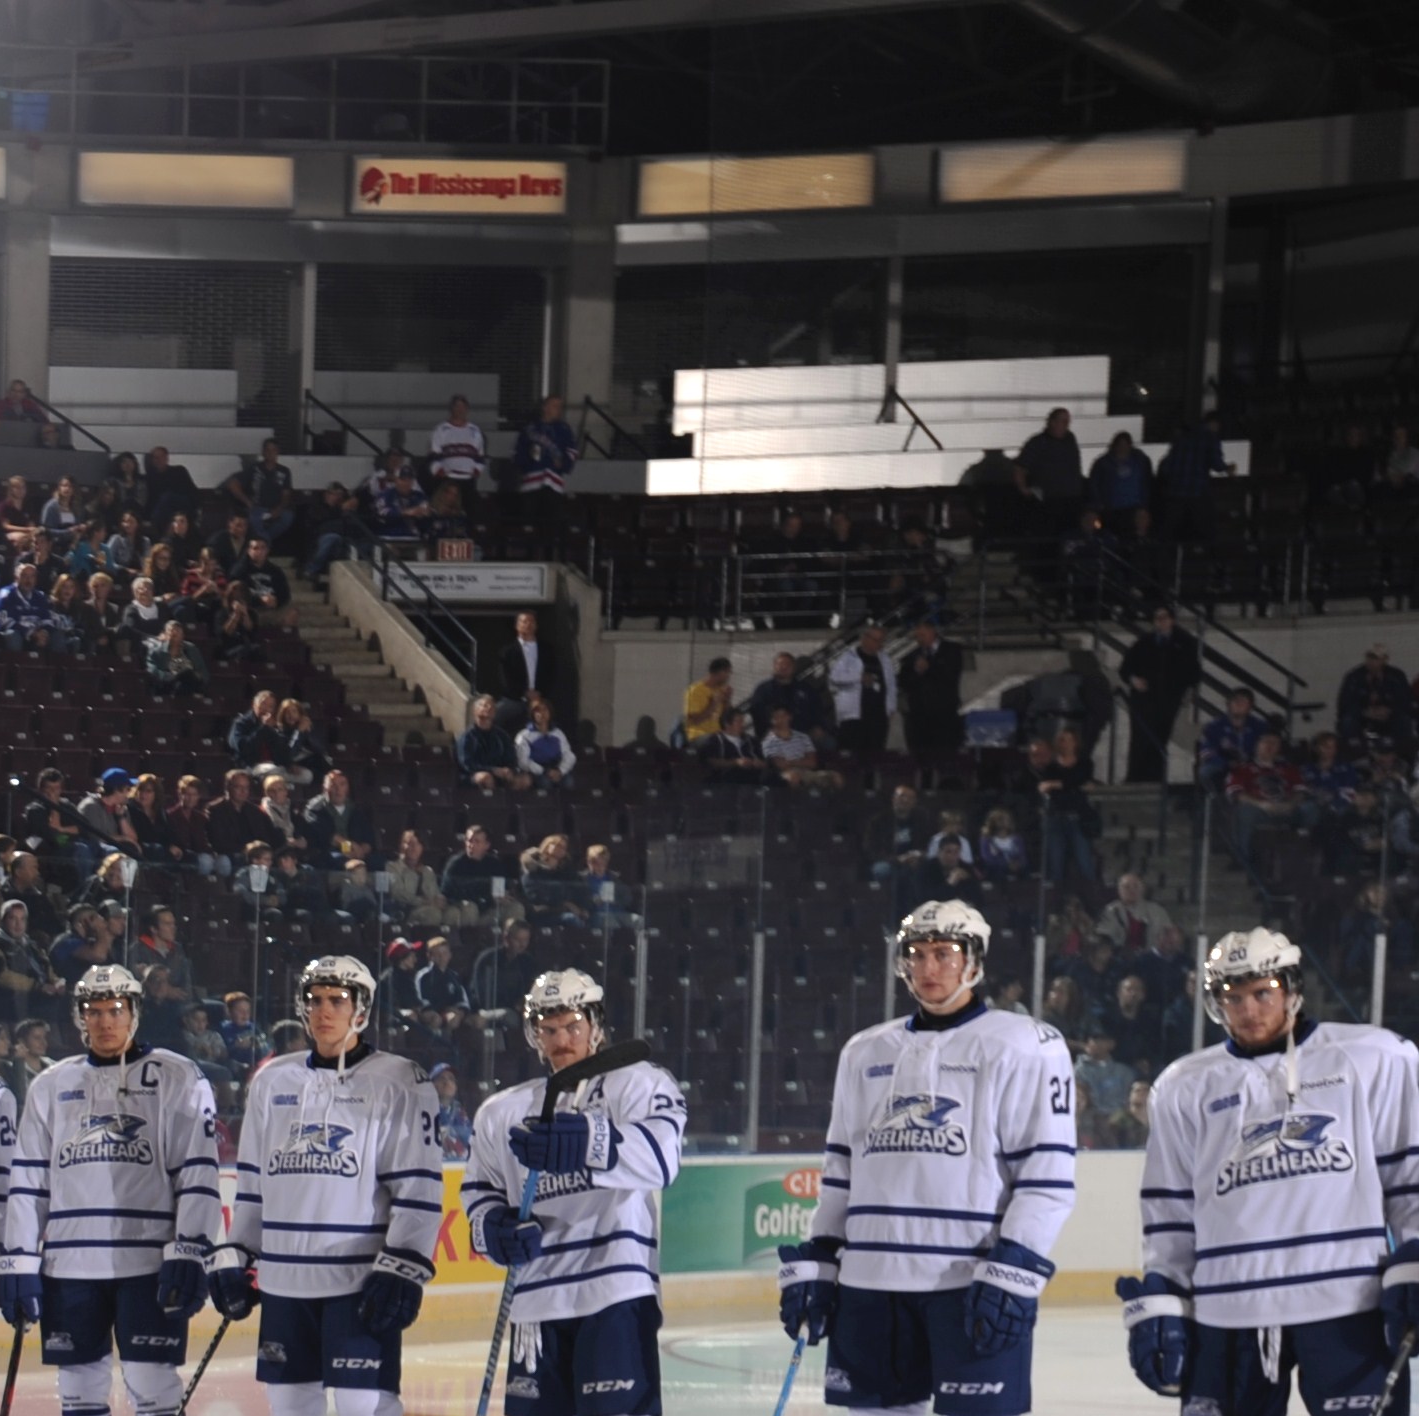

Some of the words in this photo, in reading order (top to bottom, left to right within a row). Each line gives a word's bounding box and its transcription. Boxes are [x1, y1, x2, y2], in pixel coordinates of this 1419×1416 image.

[389, 173, 416, 195] The
[418, 173, 517, 199] Mississauga
[519, 173, 562, 195] News
[140, 1061, 162, 1088] C
[1050, 1076, 1071, 1114] 21
[60, 1138, 153, 1168] STEELHEADS
[268, 1150, 359, 1177] STEELHEADS
[1217, 1140, 1355, 1194] STEELHEADS
[376, 1256, 433, 1282] CCM
[985, 1264, 1039, 1288] Reebok
[130, 1334, 180, 1346] CCM
[332, 1358, 382, 1369] CCM
[583, 1380, 634, 1394] CCM
[940, 1382, 1005, 1395] CCM
